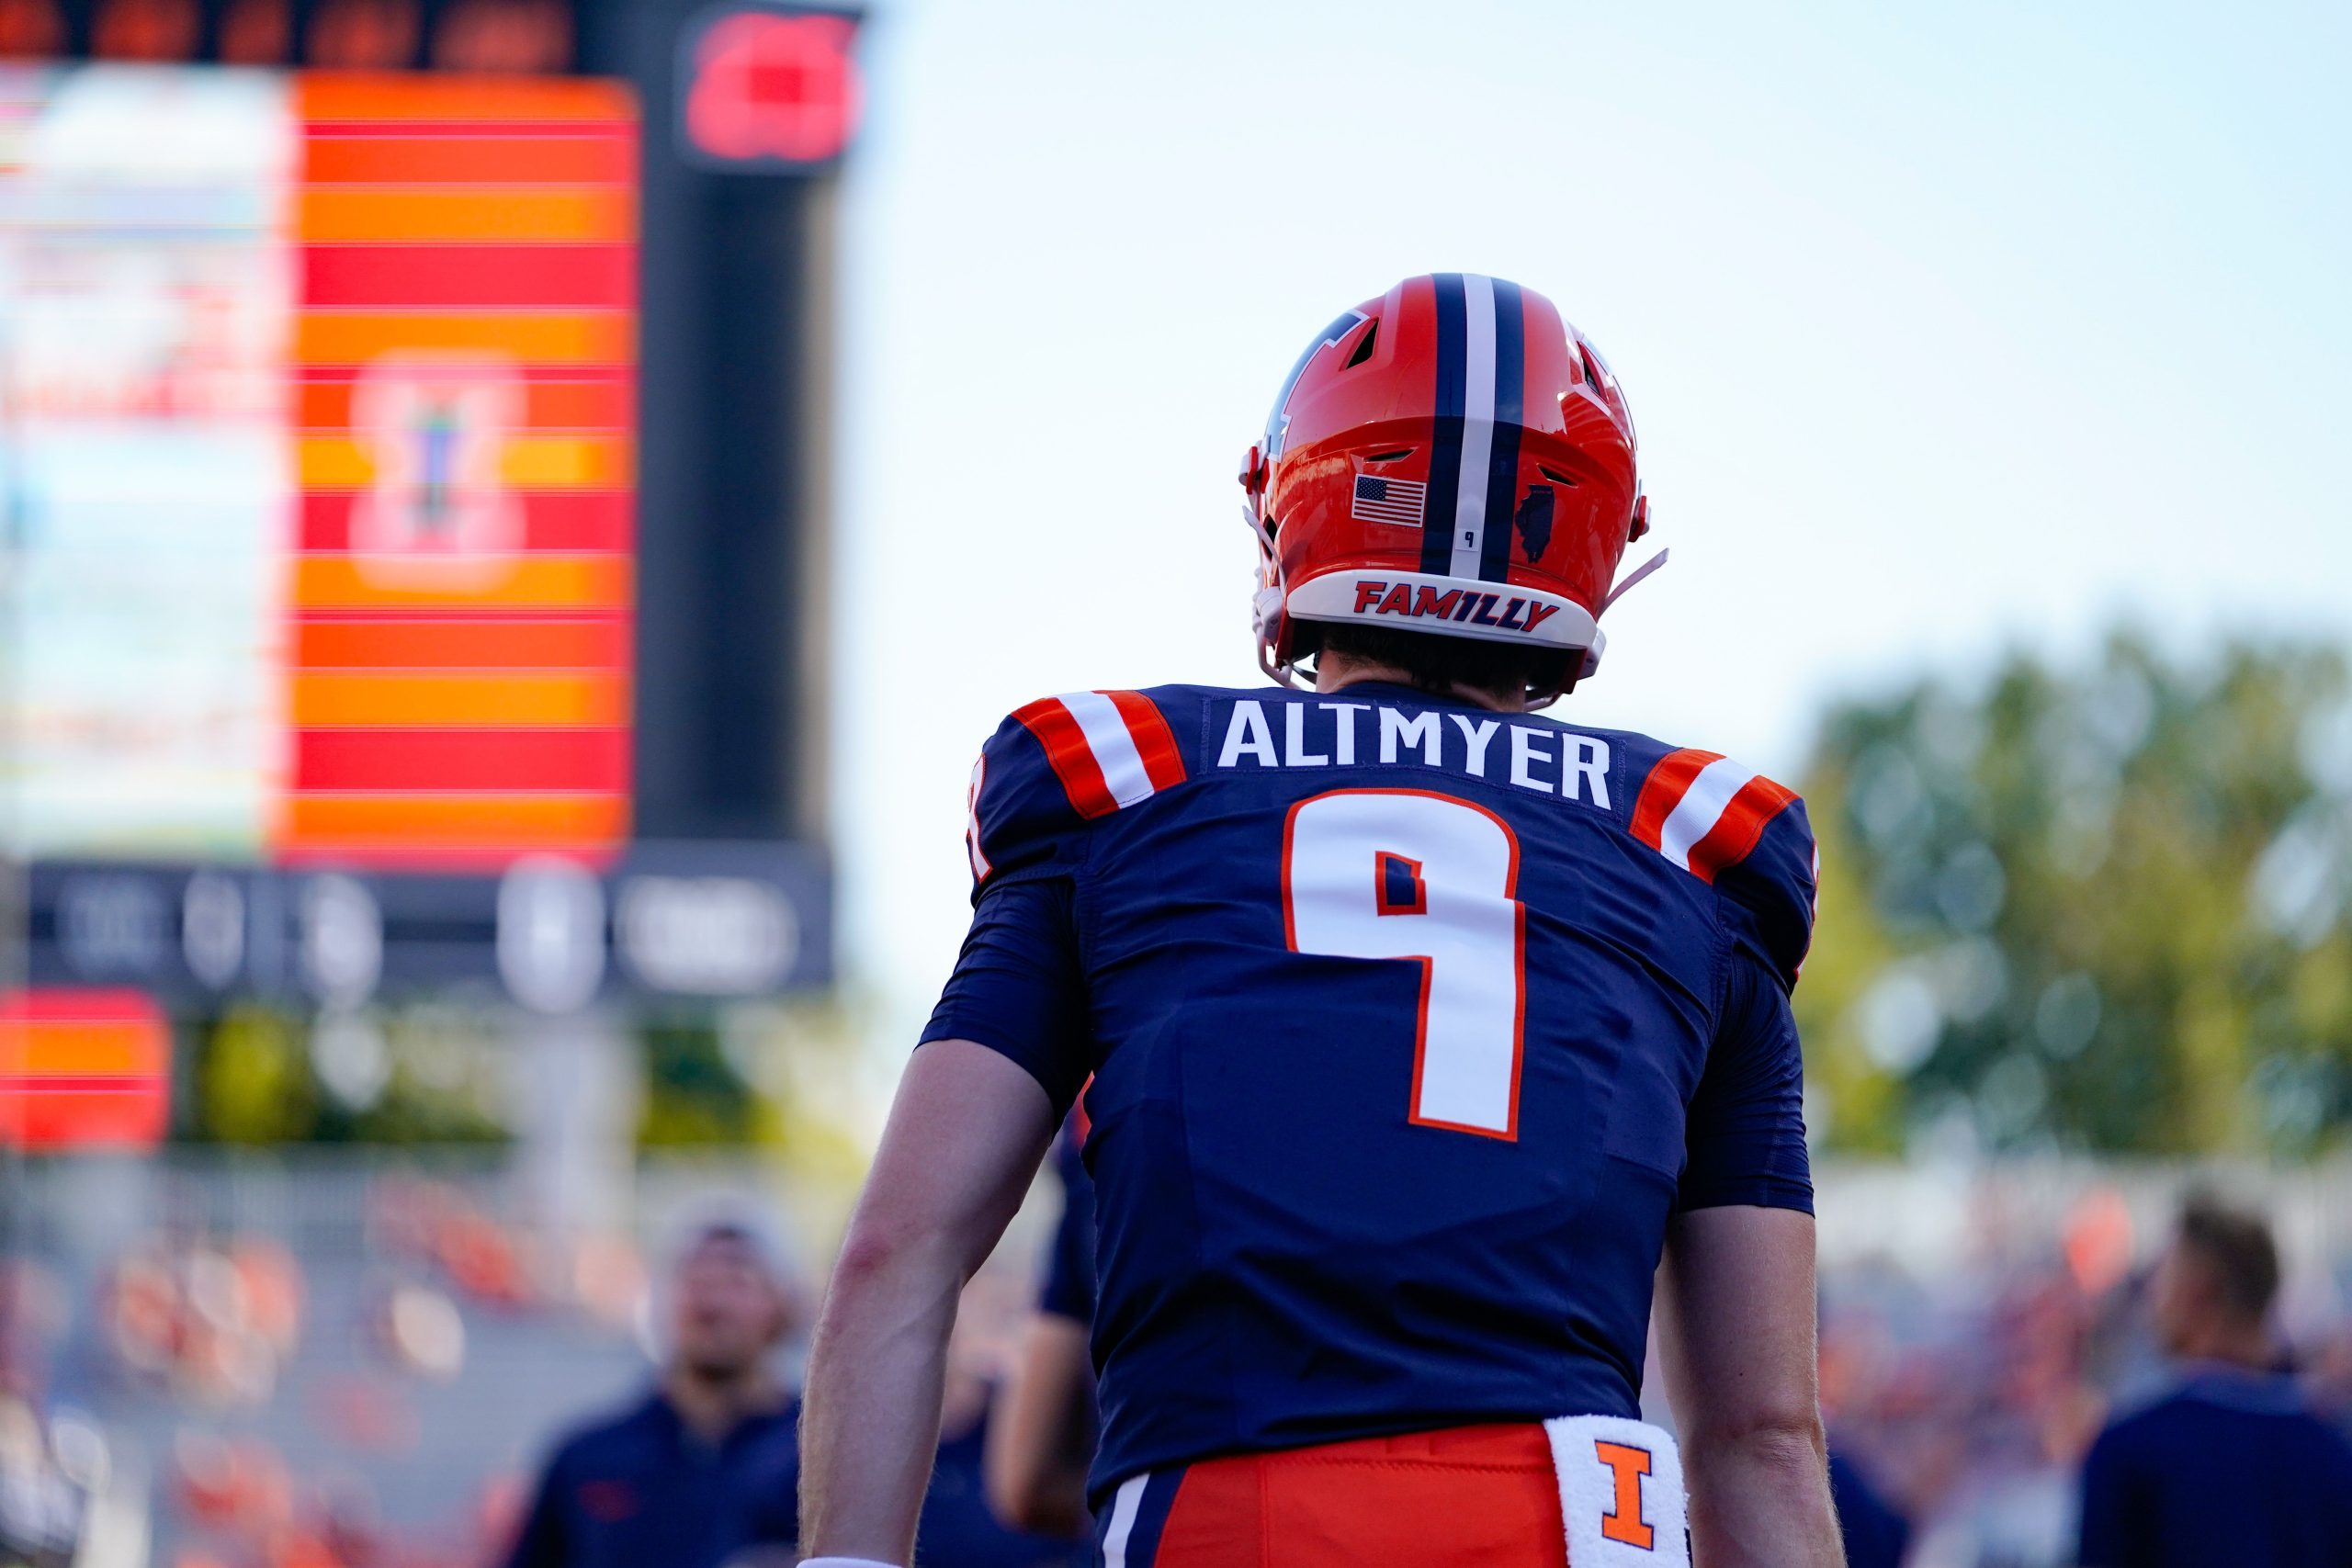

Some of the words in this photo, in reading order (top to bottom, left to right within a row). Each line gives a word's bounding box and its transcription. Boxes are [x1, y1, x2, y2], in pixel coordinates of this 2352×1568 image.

[1464, 531, 1475, 548] 9
[1353, 581, 1560, 632] FAMILLY
[1217, 700, 1611, 811] ALTMYER
[1281, 787, 1526, 1143] 9
[1595, 1439, 1654, 1551] I
